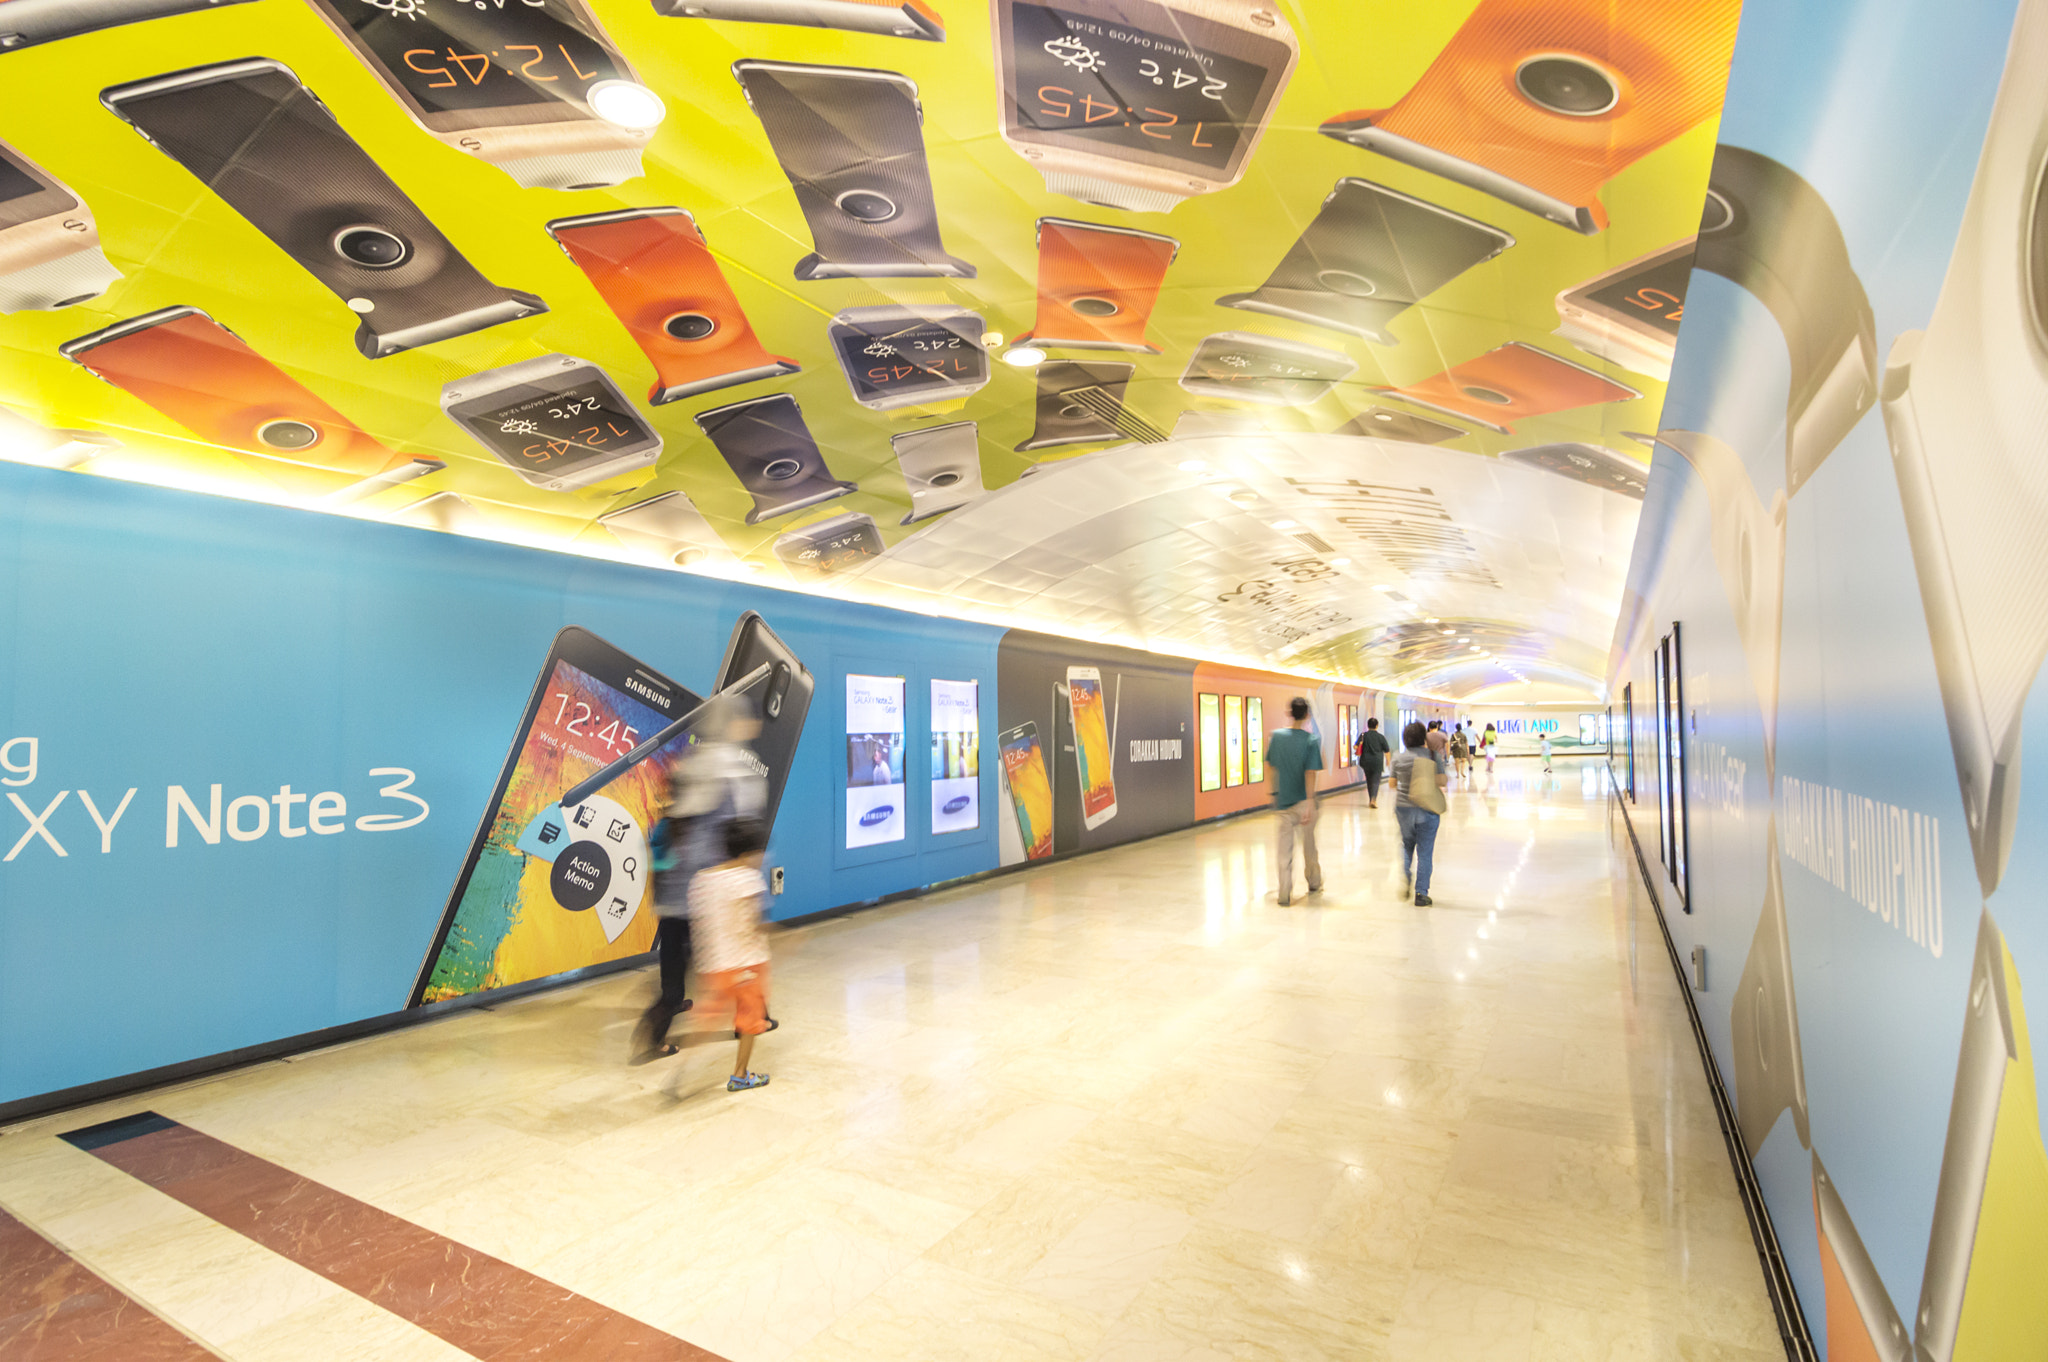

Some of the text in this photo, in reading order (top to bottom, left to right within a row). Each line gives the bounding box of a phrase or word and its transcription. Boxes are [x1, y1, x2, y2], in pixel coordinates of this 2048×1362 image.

[403, 44, 598, 88] 12:45
[1109, 29, 1150, 47] 04/09
[1155, 41, 1214, 67] Updated
[1038, 86, 1213, 147] 12:45
[868, 358, 968, 383] 12:45
[523, 422, 629, 464] 12:45
[624, 677, 671, 709] SAMSUNG
[539, 731, 559, 748] Wed,
[561, 742, 566, 750] 4
[554, 693, 639, 757] 12:45
[1497, 719, 1560, 734] IJM LAND
[166, 783, 347, 848] Note
[355, 767, 430, 832] 3
[564, 869, 594, 891] Memo
[569, 856, 600, 878] Action
[1783, 775, 1943, 959] CORAKKAN HIDUPMU
